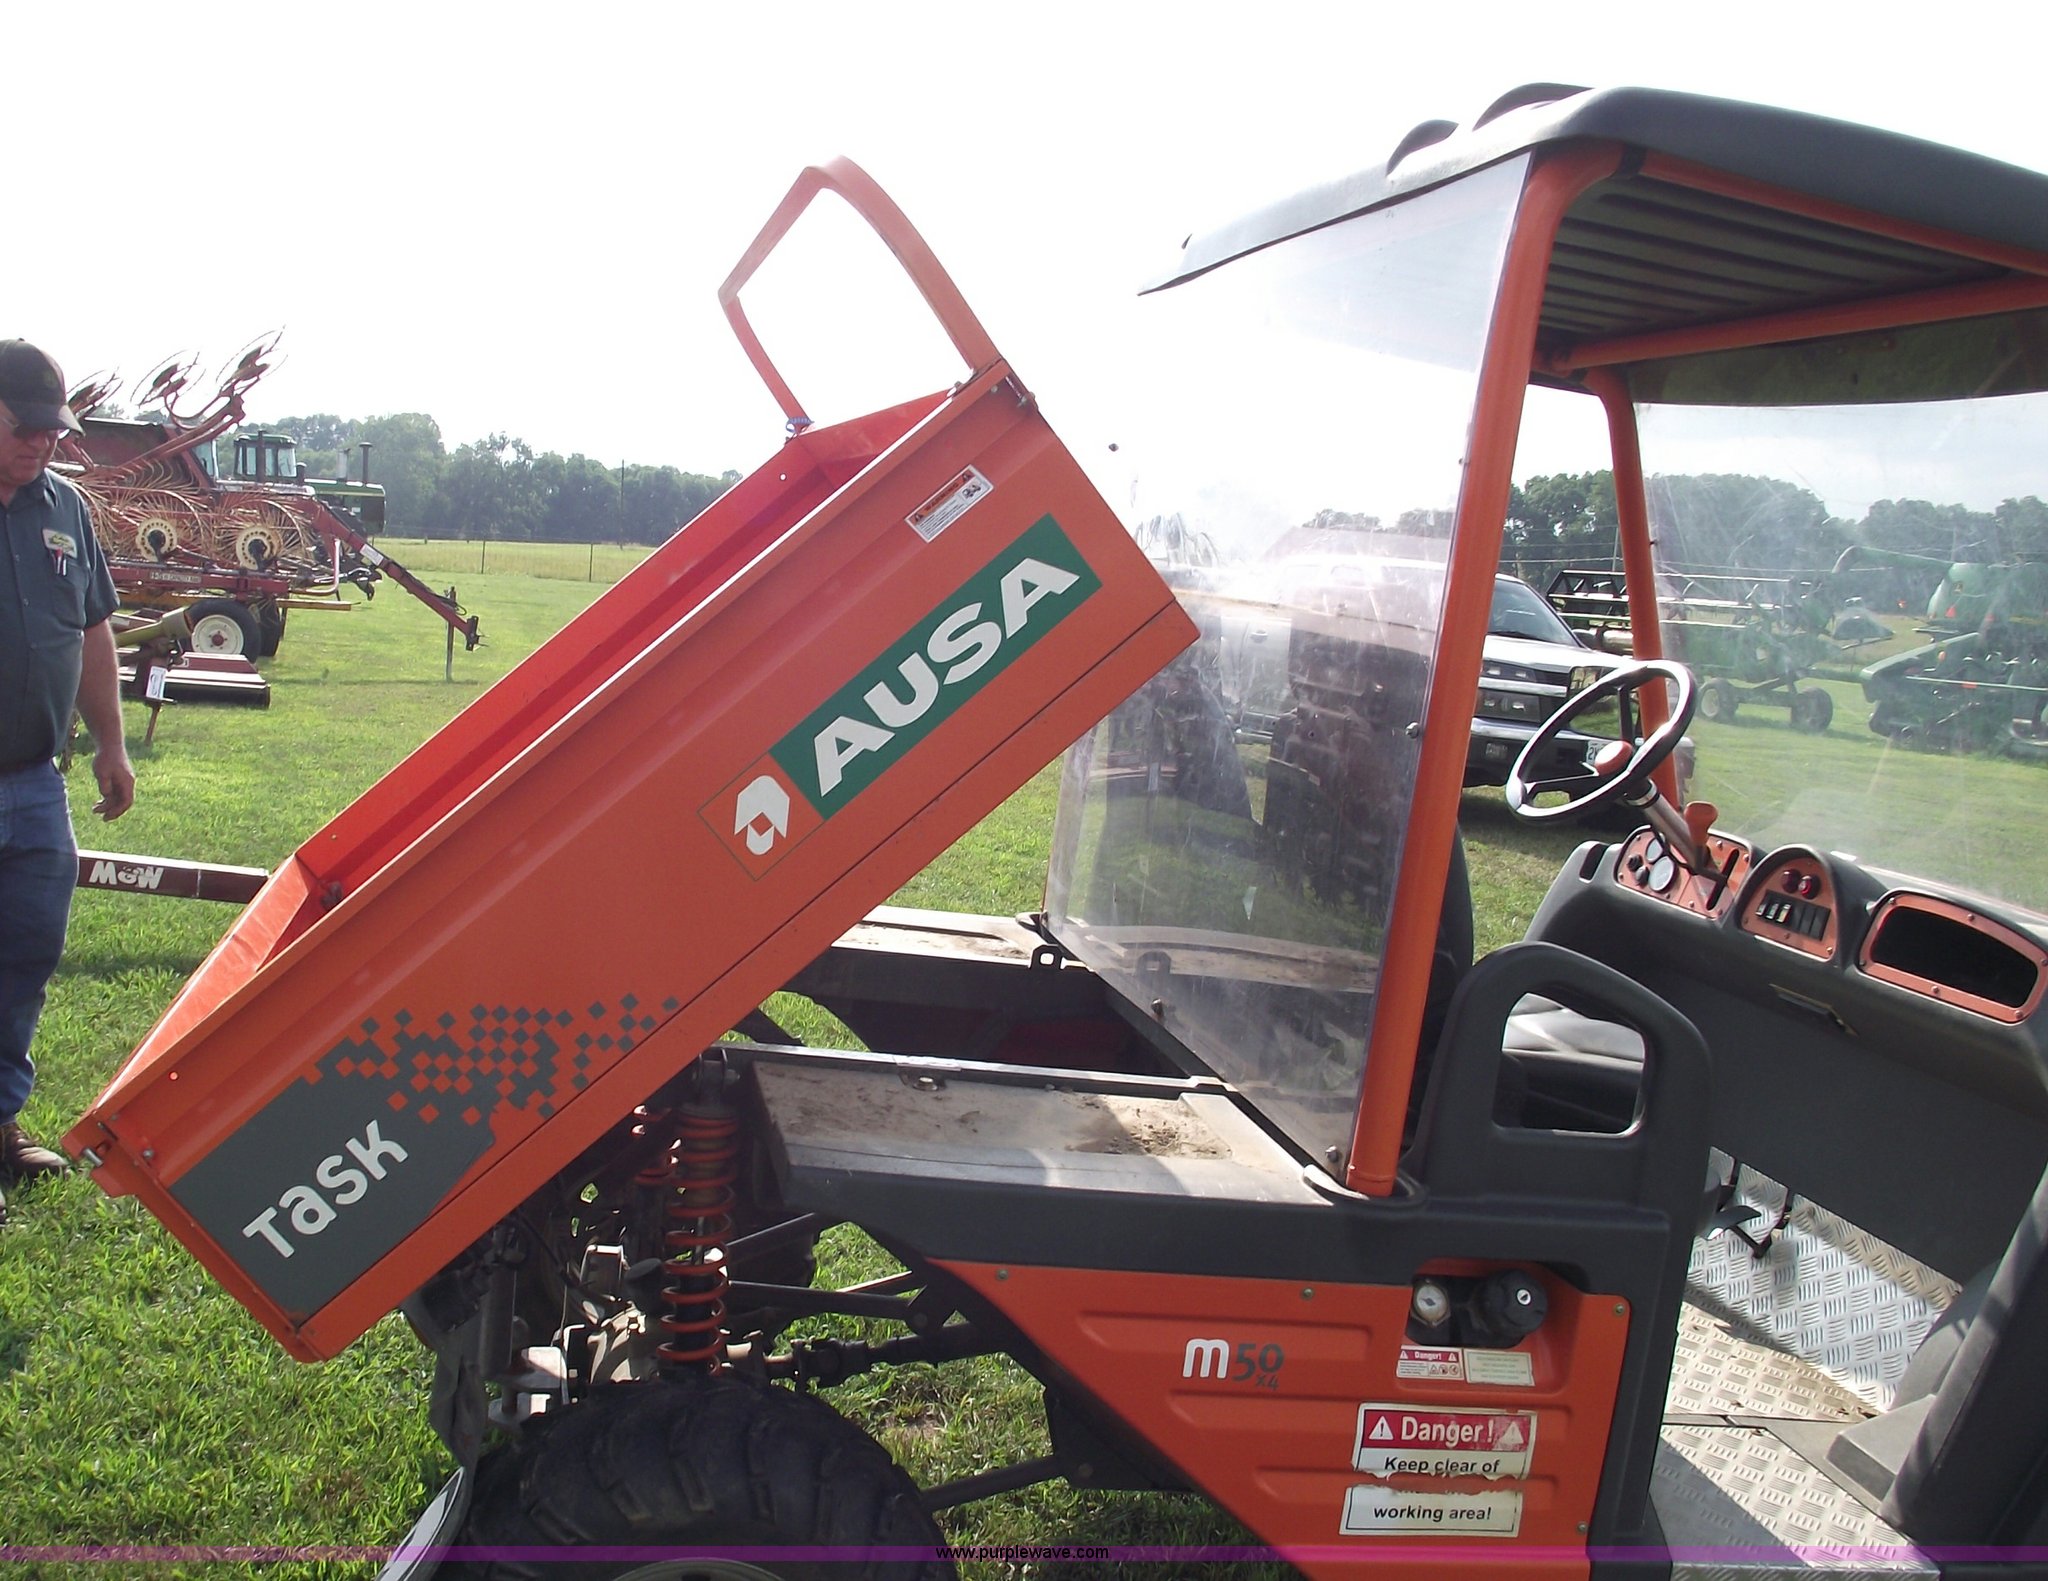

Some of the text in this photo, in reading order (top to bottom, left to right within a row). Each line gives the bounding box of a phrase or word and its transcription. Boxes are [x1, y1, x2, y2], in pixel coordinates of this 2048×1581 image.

[814, 557, 1081, 798] AUSA
[89, 860, 164, 889] M&W
[242, 1119, 409, 1259] Task
[1414, 1350, 1442, 1361] Danger!
[1384, 1456, 1501, 1474] Keep clear of
[1374, 1505, 1492, 1523] working area!
